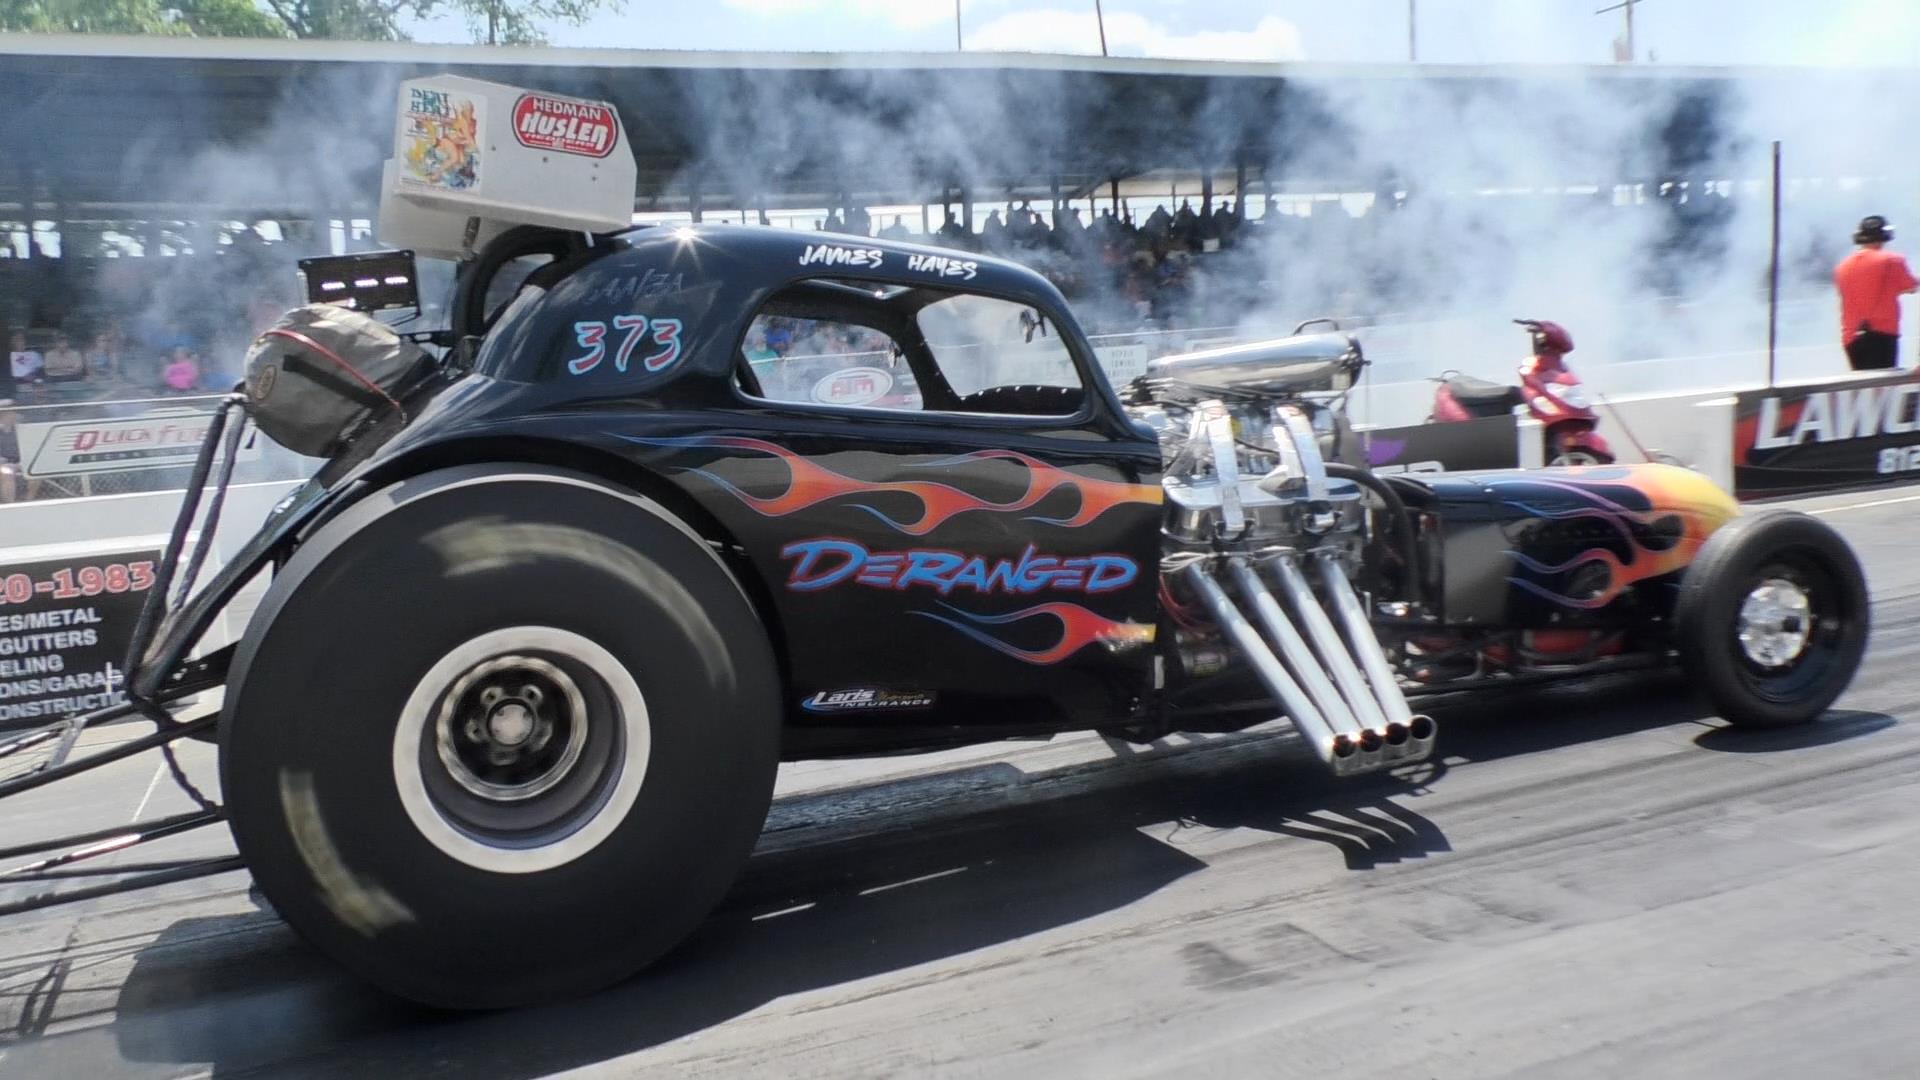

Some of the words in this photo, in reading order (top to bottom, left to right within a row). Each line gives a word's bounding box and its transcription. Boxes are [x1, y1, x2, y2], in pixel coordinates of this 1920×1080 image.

[532, 98, 601, 120] HEDMAN
[520, 111, 609, 151] HUSLER
[799, 245, 883, 269] JAMES
[907, 254, 977, 280] HAYES
[568, 315, 683, 375] 373
[780, 539, 1139, 594] DERANGED
[0, 629, 98, 655] GUTTERS
